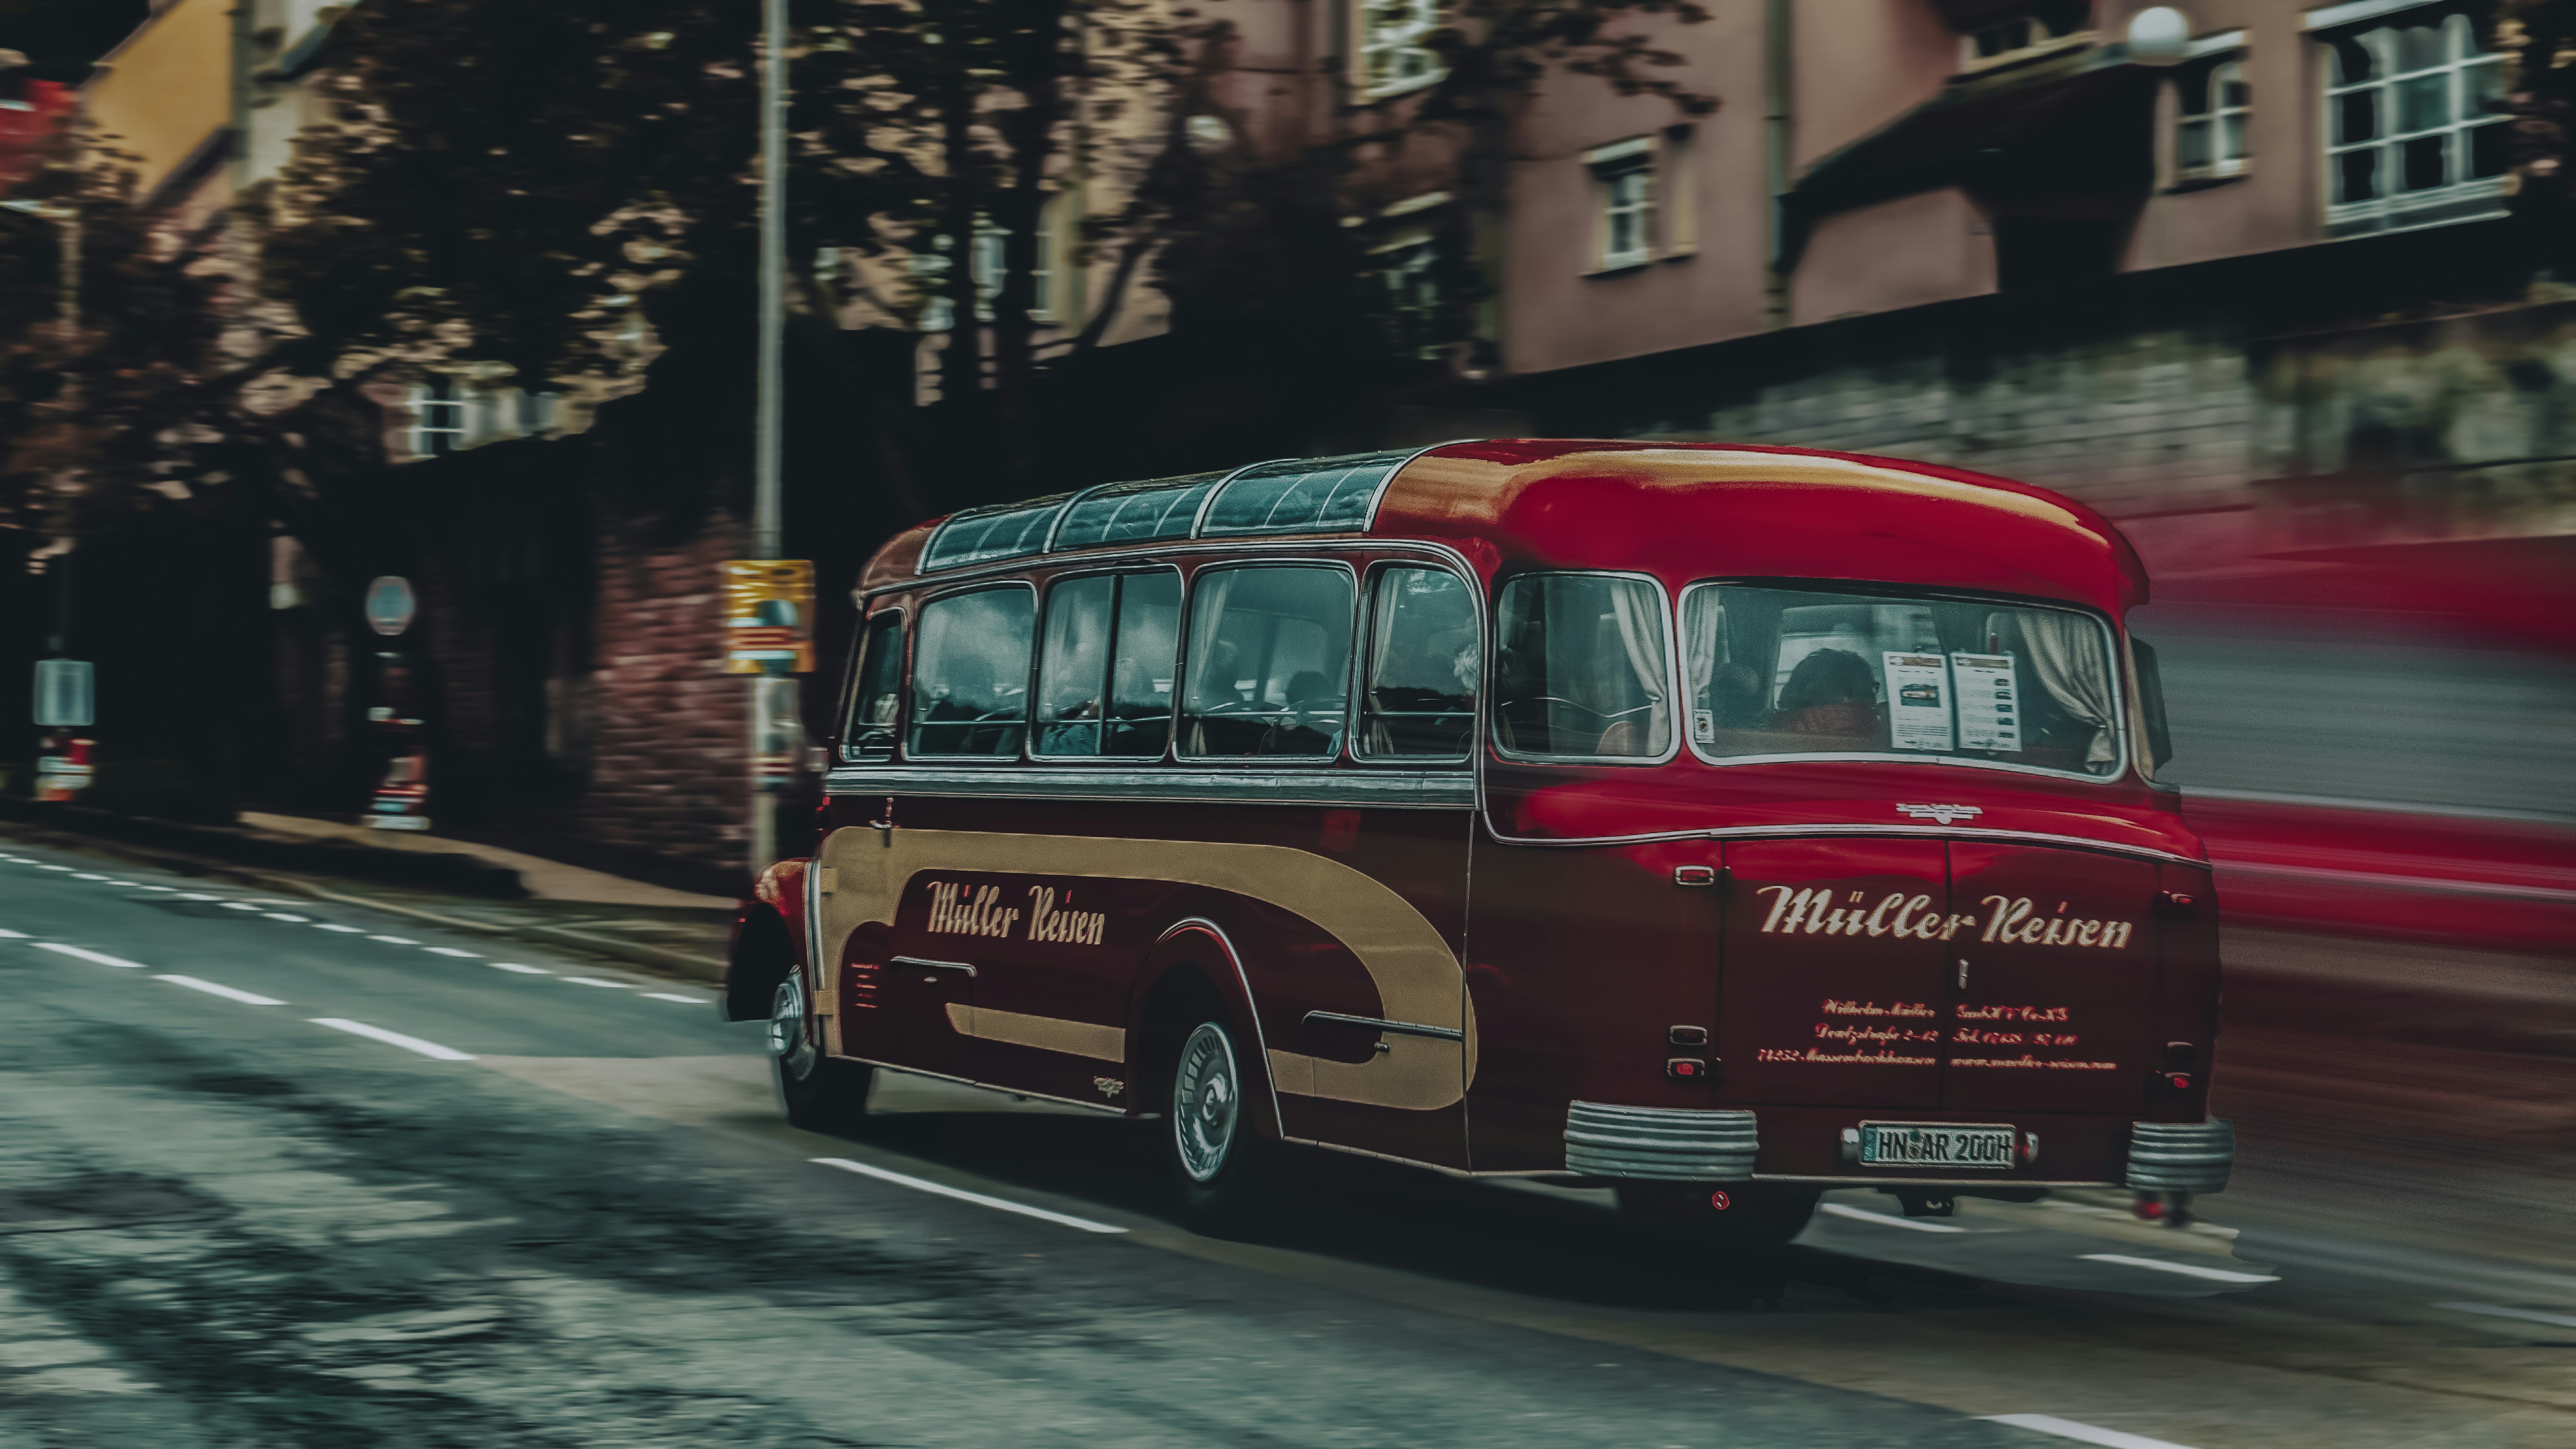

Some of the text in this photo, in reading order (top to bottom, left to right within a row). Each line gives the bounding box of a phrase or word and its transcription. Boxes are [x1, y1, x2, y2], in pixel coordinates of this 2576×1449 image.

[926, 881, 1105, 945] Müller Reisen
[1755, 885, 2133, 949] Müller Reisen
[1879, 1131, 2013, 1162] HN AR 200H
